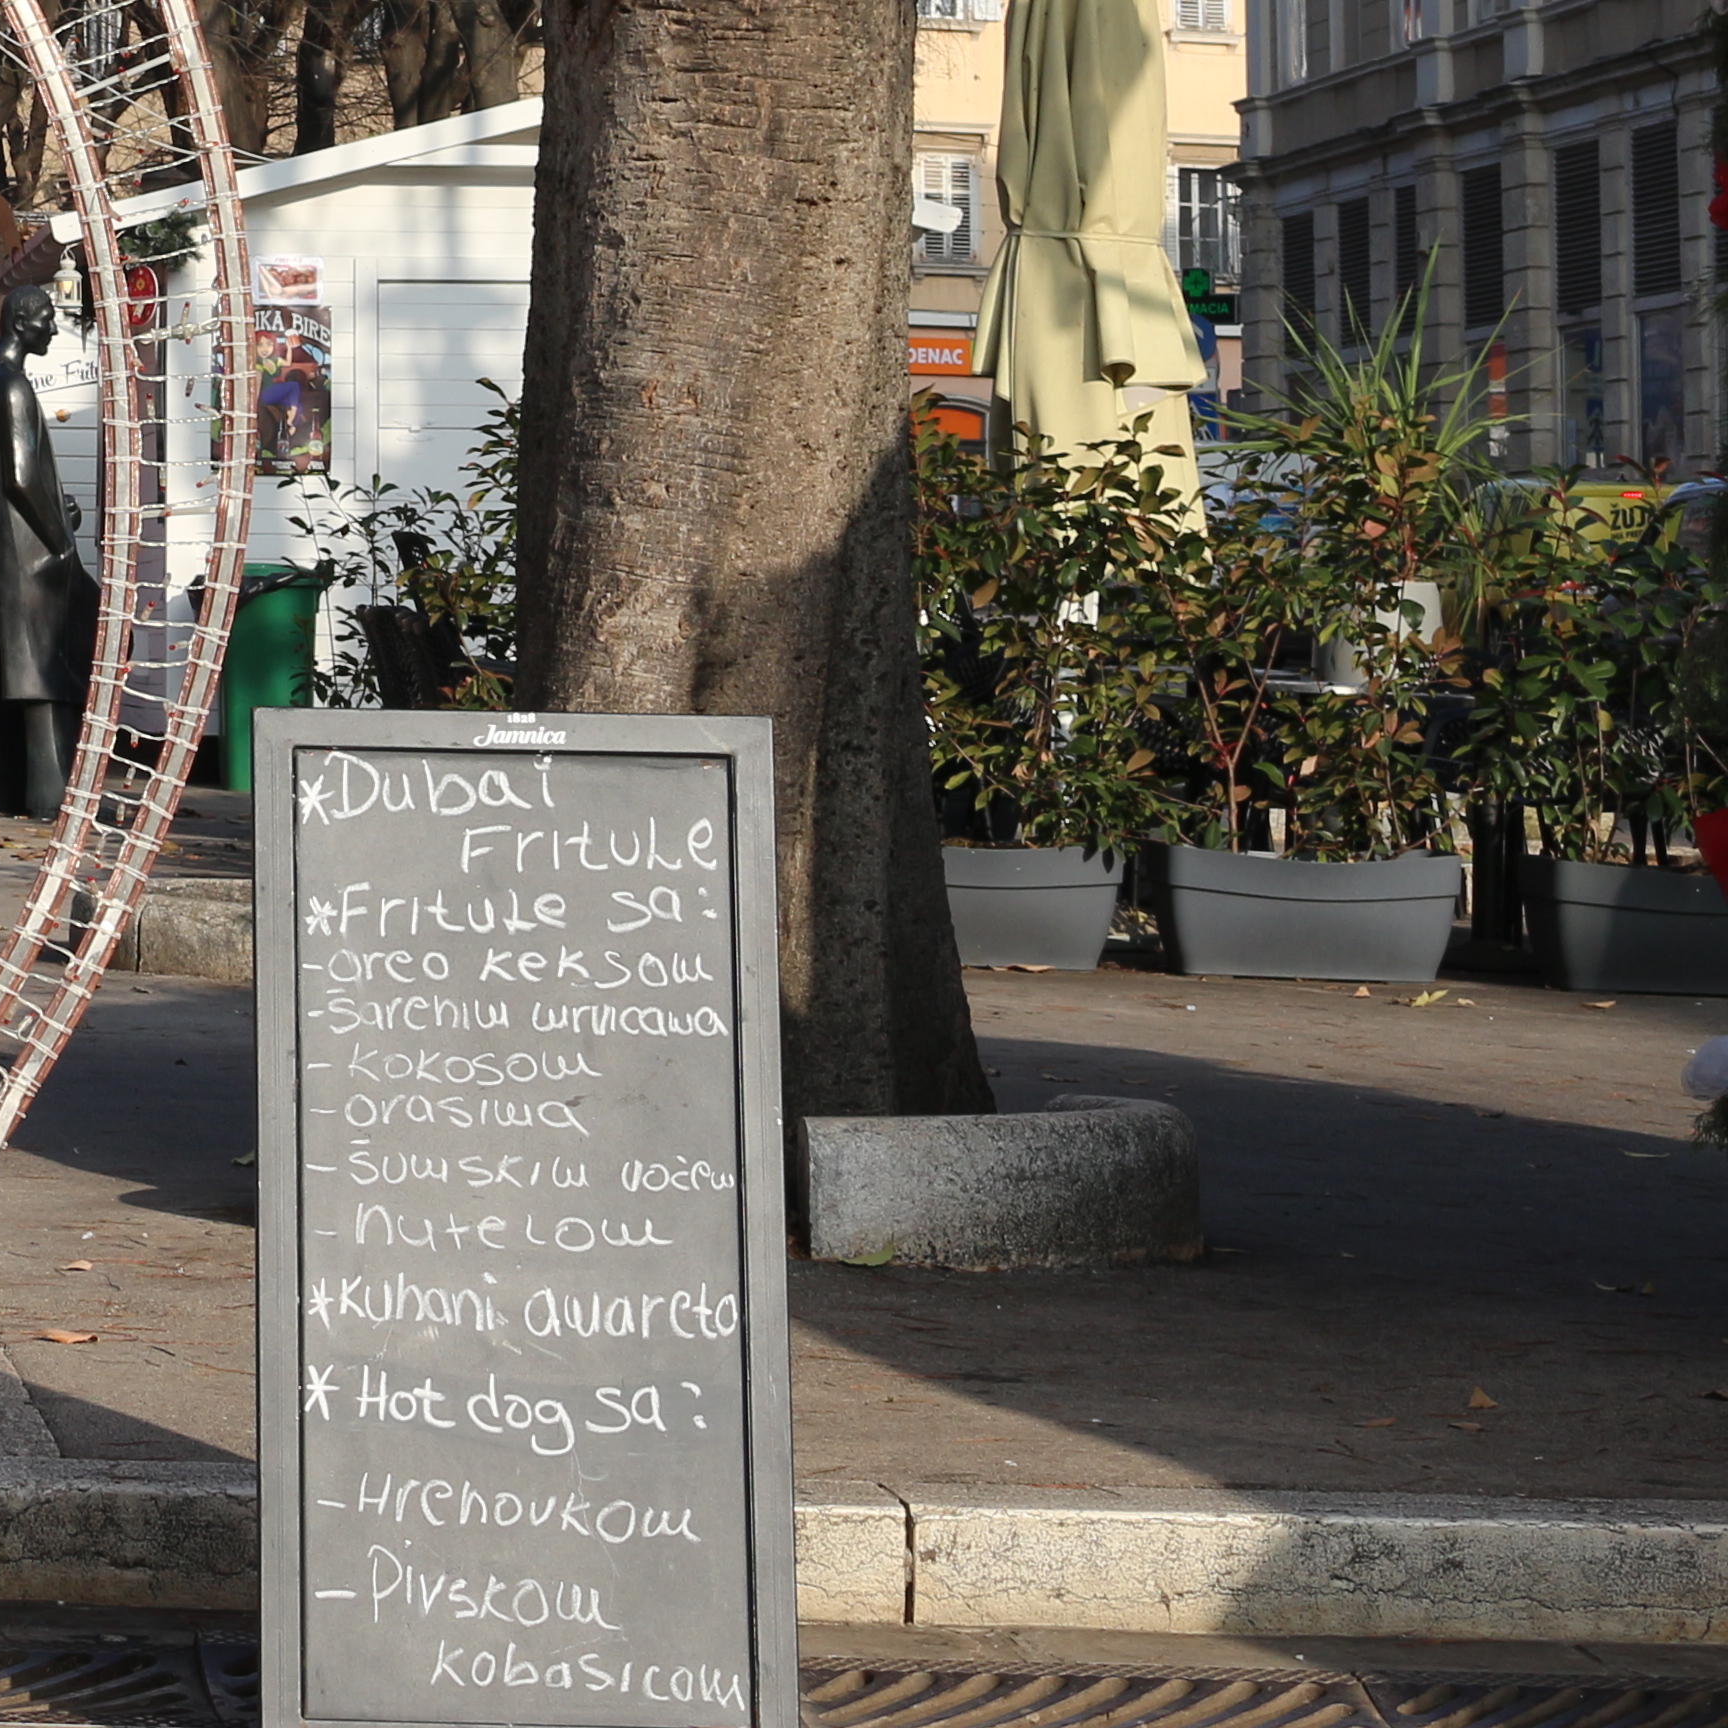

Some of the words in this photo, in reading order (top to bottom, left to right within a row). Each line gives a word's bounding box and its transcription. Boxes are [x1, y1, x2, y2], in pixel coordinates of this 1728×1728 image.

[291, 312, 331, 348] BIRE
[1609, 503, 1646, 530] ŽUJ
[507, 712, 536, 723] 1828
[473, 724, 567, 747] Jamnica
[325, 752, 555, 820] Dubai
[356, 1364, 456, 1429] Hot
[467, 1372, 576, 1456] dog
